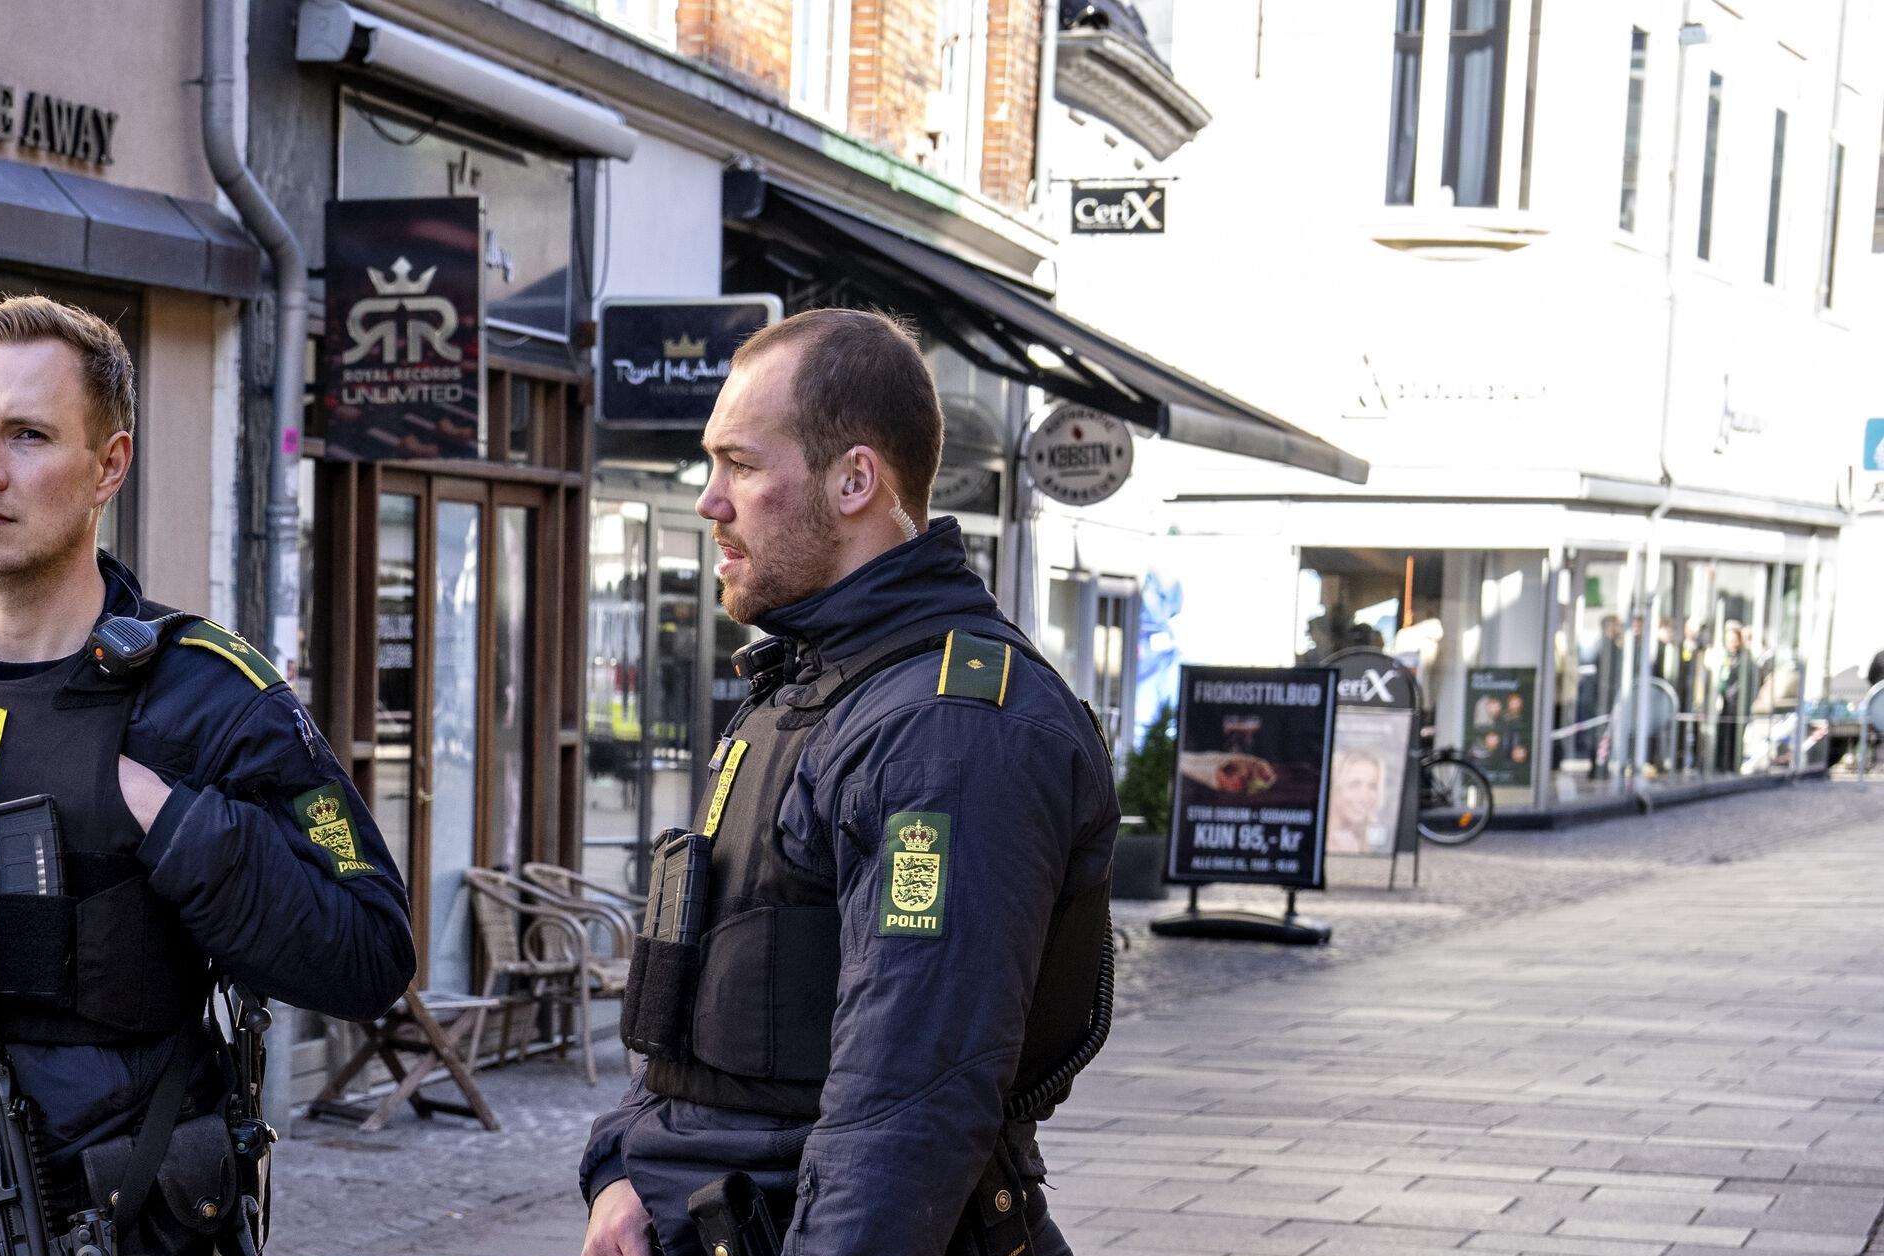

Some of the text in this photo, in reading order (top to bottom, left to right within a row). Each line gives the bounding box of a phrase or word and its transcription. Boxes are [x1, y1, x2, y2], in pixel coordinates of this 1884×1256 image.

[19, 91, 119, 165] AWAY
[1074, 190, 1163, 230] CeriX
[342, 366, 462, 382] ROYAL RECORDS
[341, 383, 464, 405] UNLIMITED
[1193, 680, 1322, 706] FROKOSTTILBUD
[1336, 669, 1400, 703] eriX
[1193, 822, 1237, 850] KUN
[1279, 824, 1305, 852] kr
[886, 914, 937, 929] POLITI
